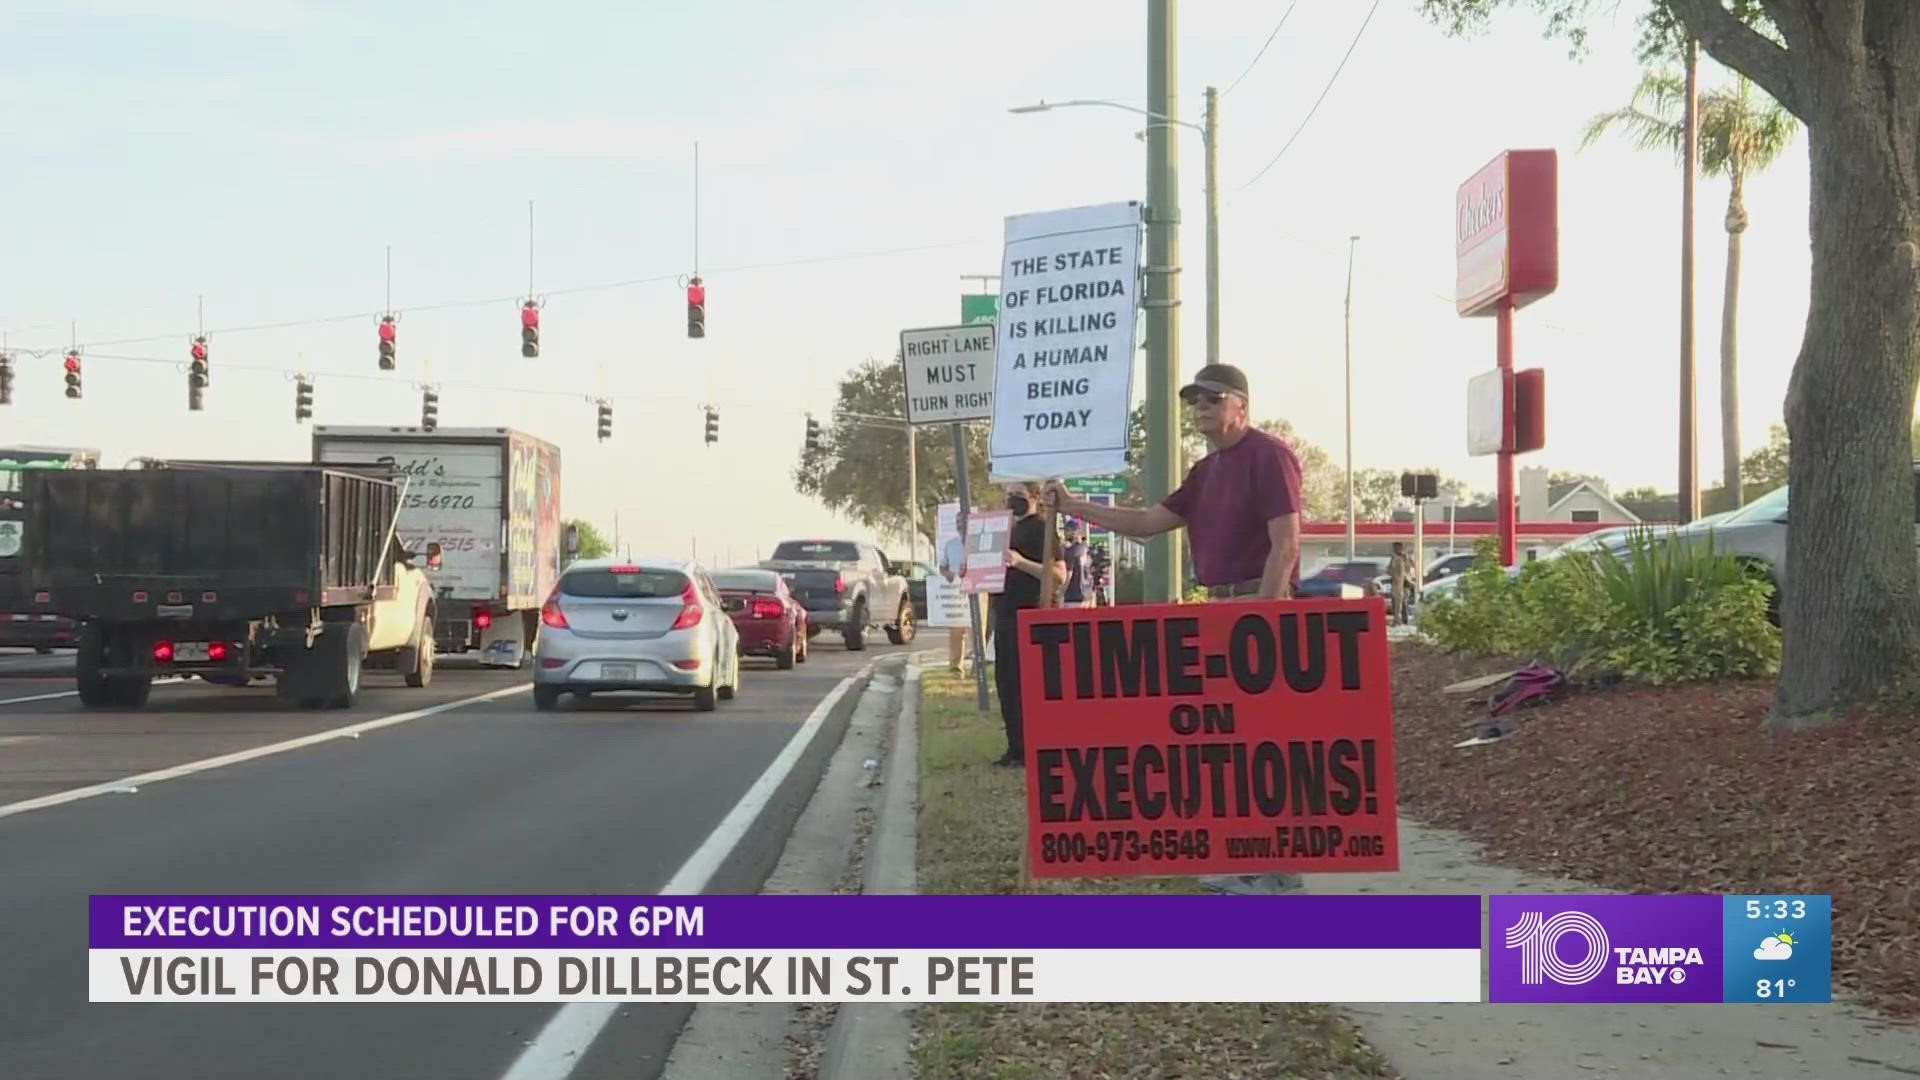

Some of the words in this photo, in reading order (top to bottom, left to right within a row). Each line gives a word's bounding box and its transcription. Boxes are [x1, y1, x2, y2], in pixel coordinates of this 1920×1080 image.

[1458, 181, 1505, 243] Checkers
[1010, 256, 1048, 277] THE
[1054, 246, 1123, 271] STATE
[1005, 290, 1030, 309] OF
[1036, 279, 1125, 304] FLORIDA
[1010, 322, 1028, 339] IS
[1034, 311, 1117, 336] KILLING
[907, 339, 949, 356] RIGHT
[954, 336, 992, 353] LANE
[1013, 353, 1026, 369] A
[1033, 344, 1109, 368] HUMAN
[926, 363, 977, 384] MUST
[1026, 377, 1090, 400] BEING
[912, 396, 948, 412] TURN
[1022, 409, 1092, 431] TODAY
[1030, 611, 1370, 700] TIME-OUT
[1169, 703, 1235, 735] ON
[1037, 739, 1378, 823] EXECUTIONS!
[1041, 829, 1210, 864] 800-973-6548
